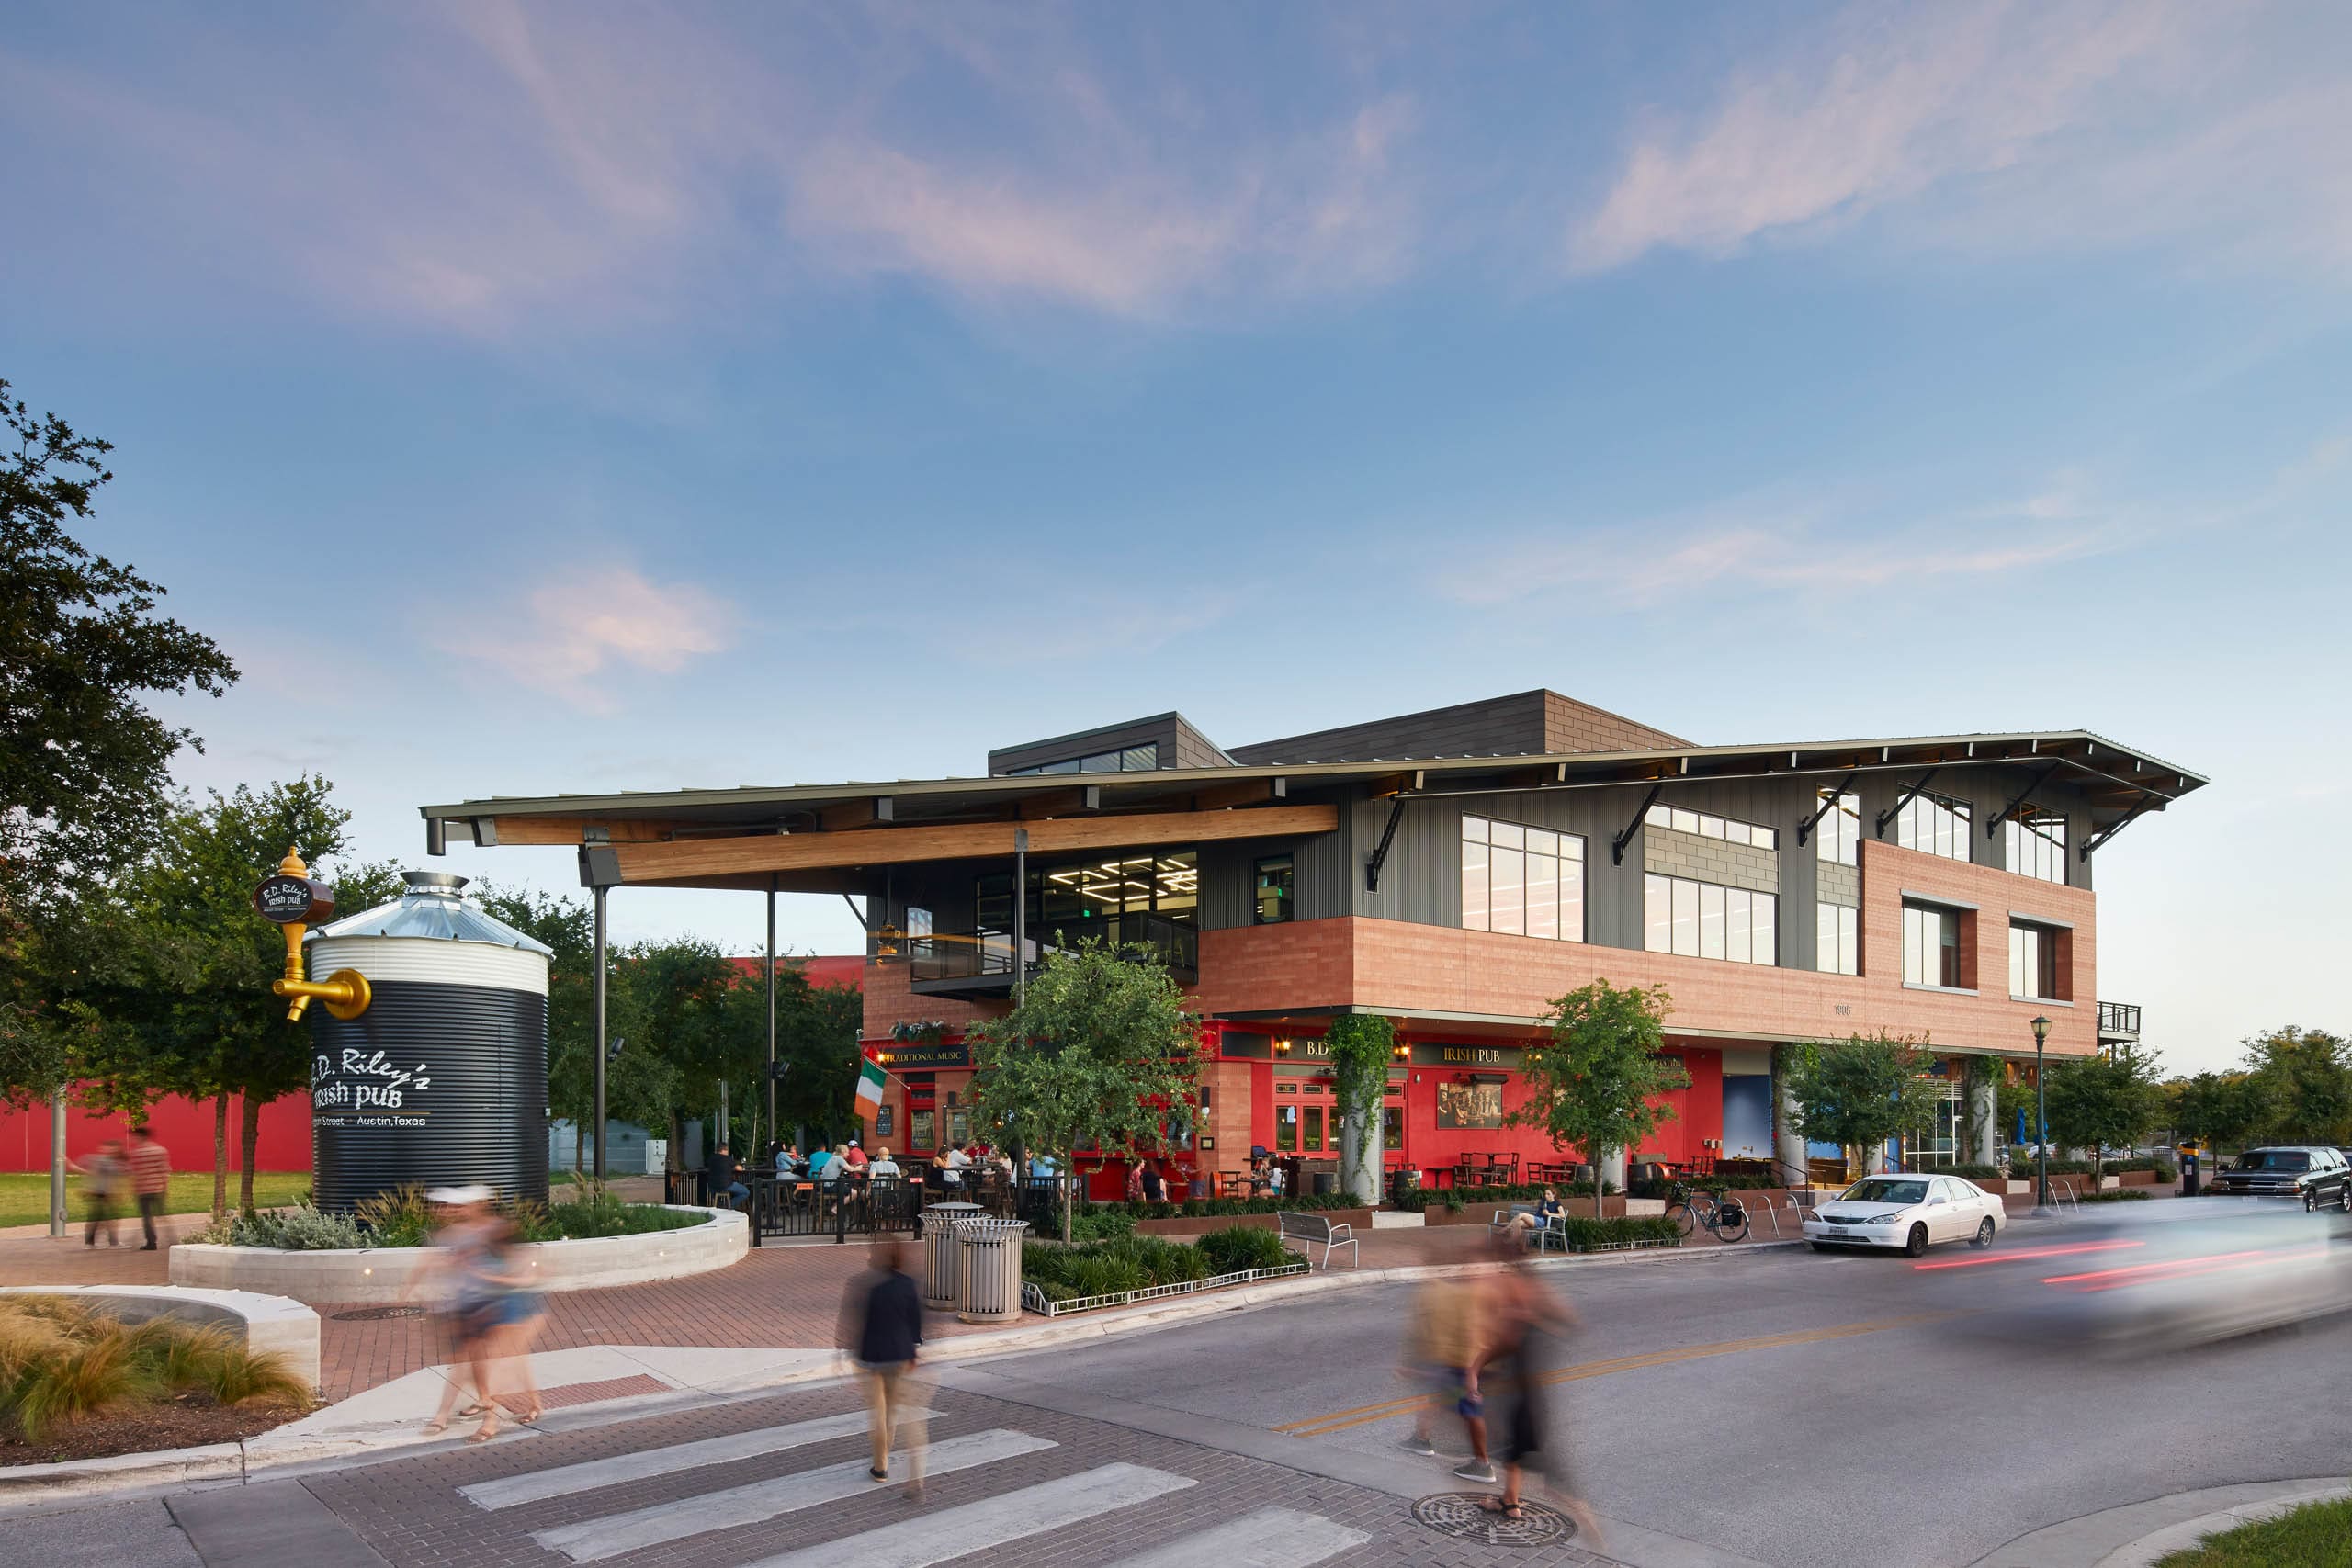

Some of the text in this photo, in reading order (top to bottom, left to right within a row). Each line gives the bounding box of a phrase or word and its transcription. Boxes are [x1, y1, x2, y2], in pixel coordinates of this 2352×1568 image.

[282, 884, 307, 898] Riley's
[886, 1051, 961, 1063] TRADITIONAL MUSIC
[1443, 1048, 1499, 1062] IRISH PUB
[341, 1048, 430, 1089] Riley's
[322, 1116, 345, 1126] Street
